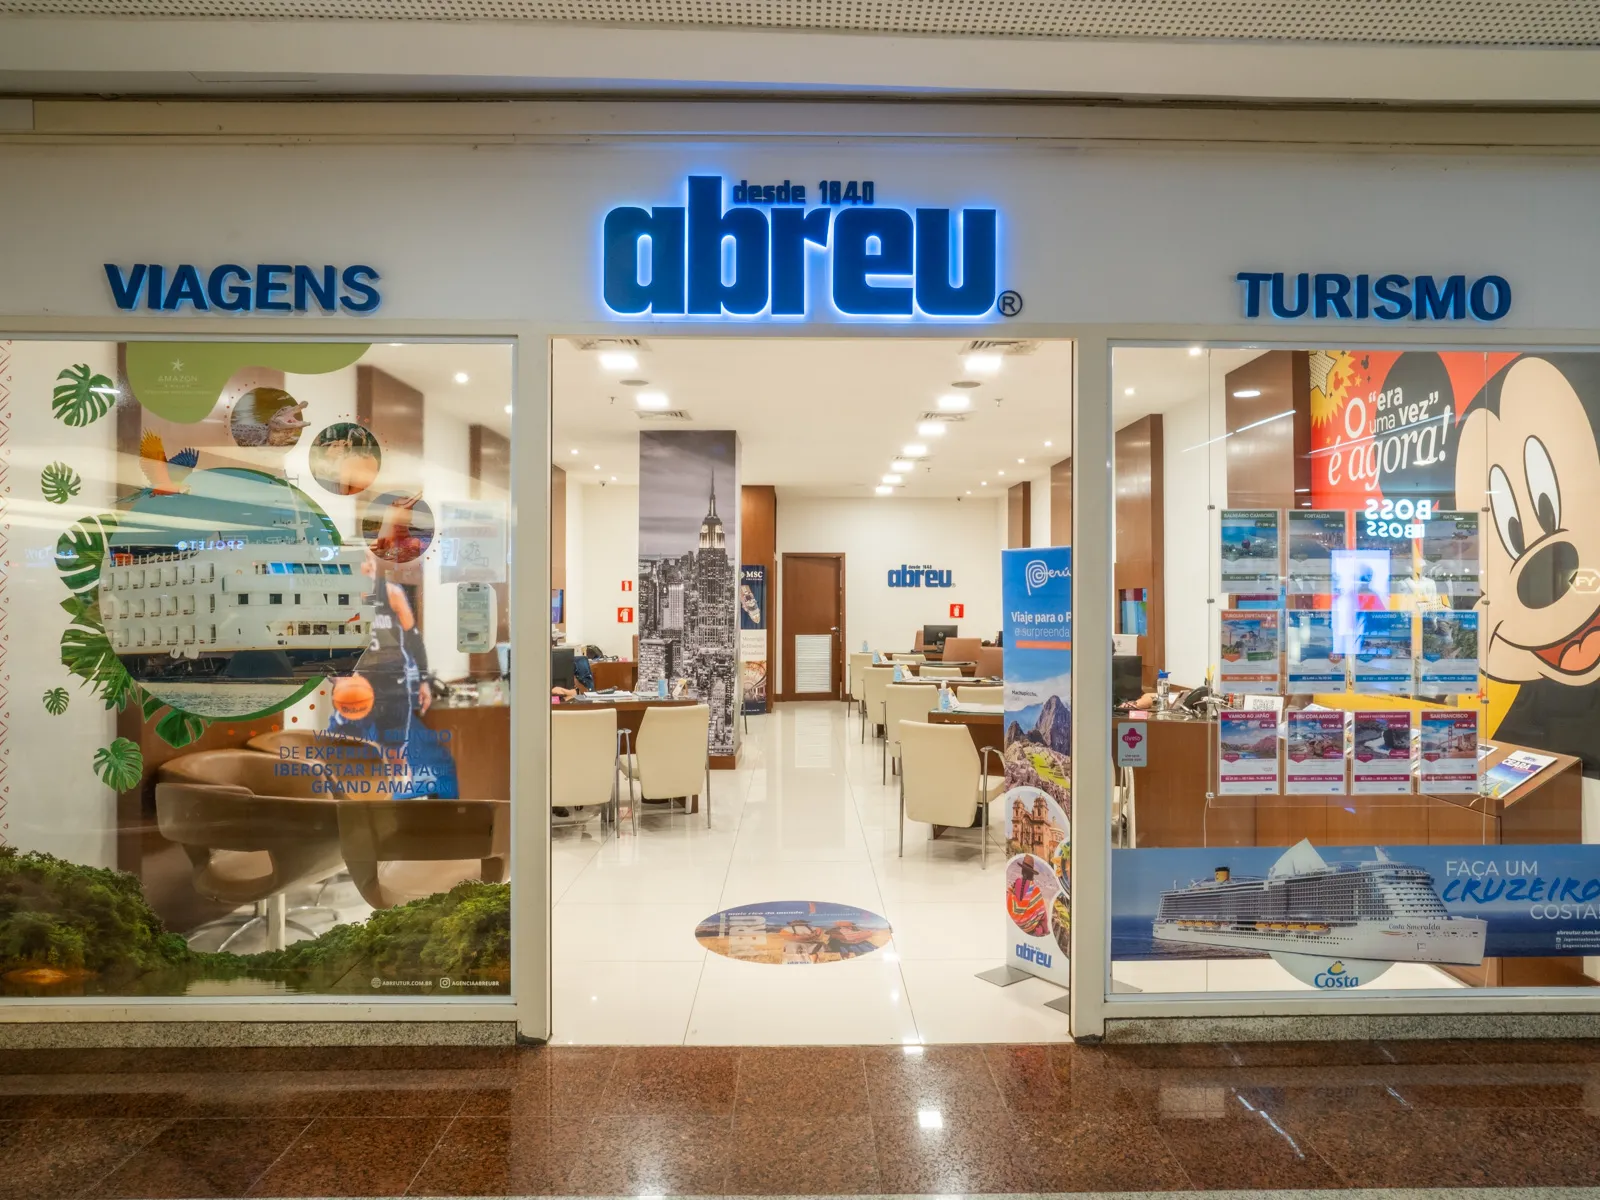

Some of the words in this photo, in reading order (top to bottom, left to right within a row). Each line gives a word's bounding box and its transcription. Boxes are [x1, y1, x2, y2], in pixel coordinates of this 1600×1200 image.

[733, 180, 806, 205] desde
[818, 180, 867, 206] 1840
[603, 175, 997, 316] abreu
[103, 263, 381, 312] VIAGENS
[1236, 272, 1512, 322] TURISMO
[1344, 397, 1367, 439] O
[1369, 414, 1396, 435] uma
[1328, 435, 1342, 486] é
[1347, 404, 1451, 492] agora!
[887, 564, 952, 588] abreu
[1011, 611, 1033, 625] Viaje
[1035, 613, 1056, 625] para
[1058, 613, 1064, 622] o
[312, 730, 349, 742] VIVA
[279, 746, 299, 760] DE
[274, 763, 365, 777] IBEROSTAR
[311, 781, 371, 794] GRAND
[376, 780, 452, 794] AMAZON
[1446, 860, 1499, 881] FAÇA
[1505, 860, 1538, 877] UM
[1442, 876, 1600, 904] CRUZEIRO
[1406, 922, 1441, 931] Smeralda
[1015, 942, 1053, 968] abreu
[1314, 972, 1359, 989] Costa
